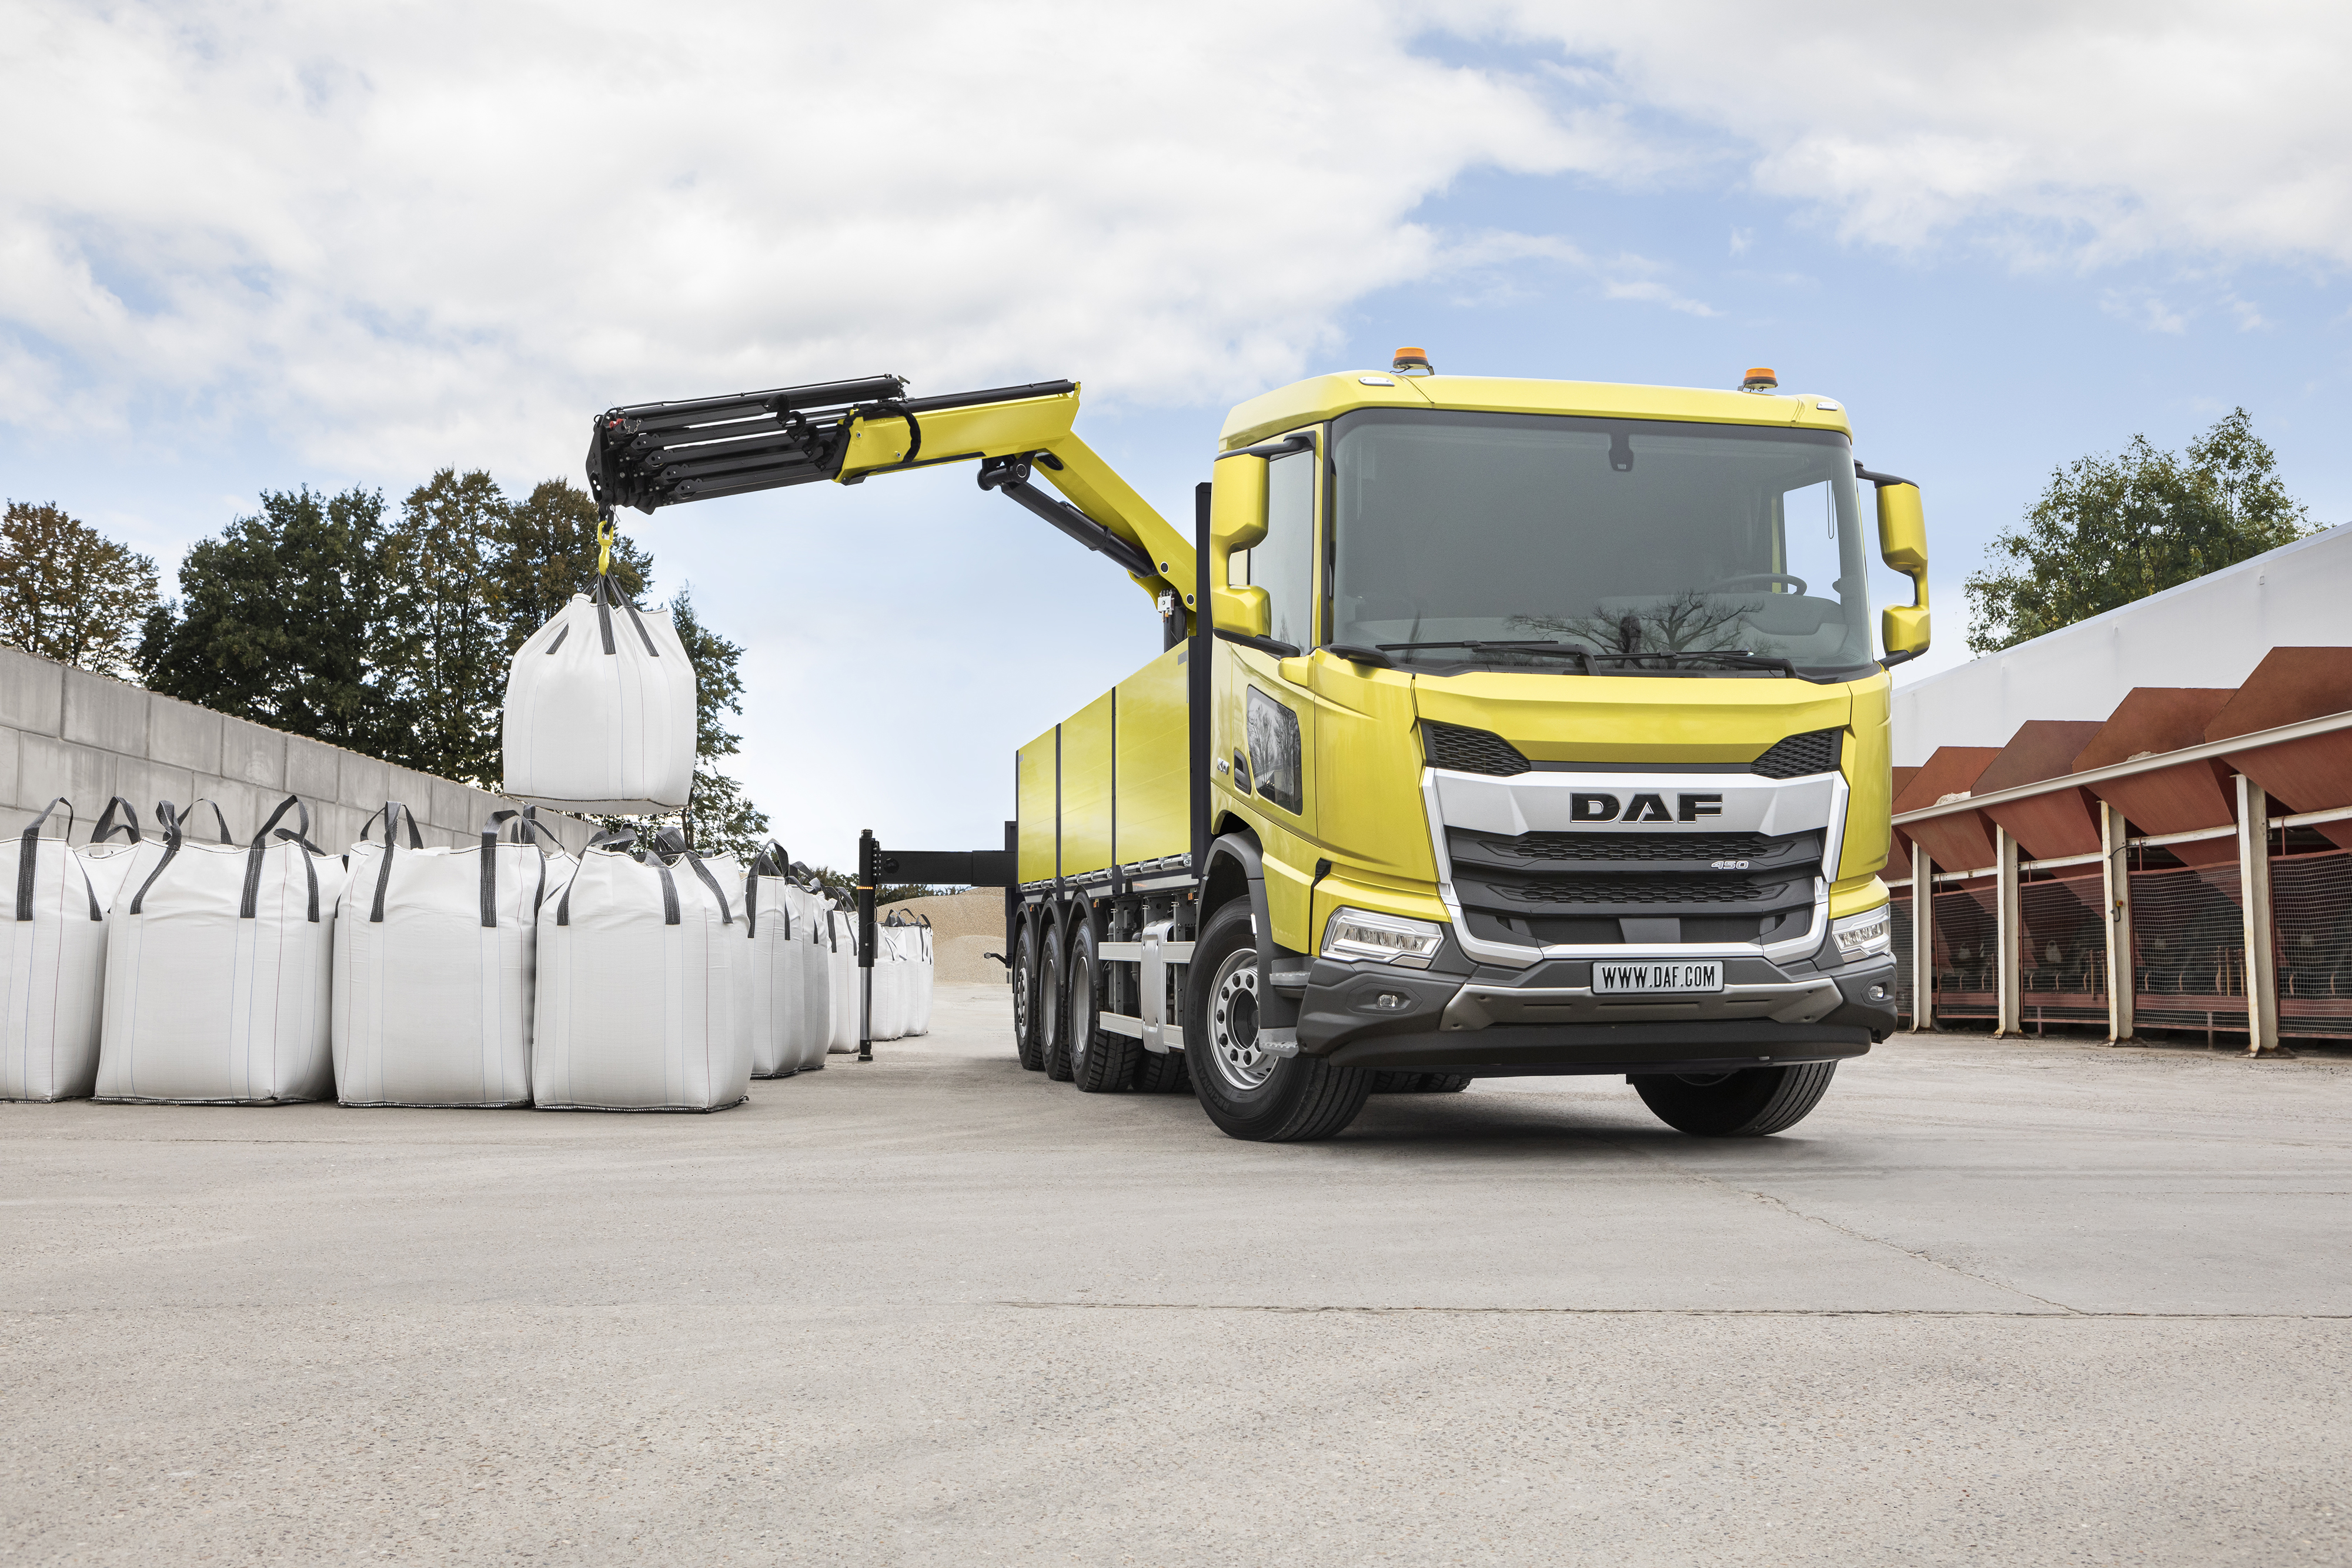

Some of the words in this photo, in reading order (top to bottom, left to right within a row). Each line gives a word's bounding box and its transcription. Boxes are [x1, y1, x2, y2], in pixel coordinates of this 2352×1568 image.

[1569, 792, 1723, 823] DAF
[1711, 861, 1749, 869] 450
[1602, 965, 1715, 988] WWW.DAF.COM
[1197, 1059, 1230, 1111] REGIONAL
